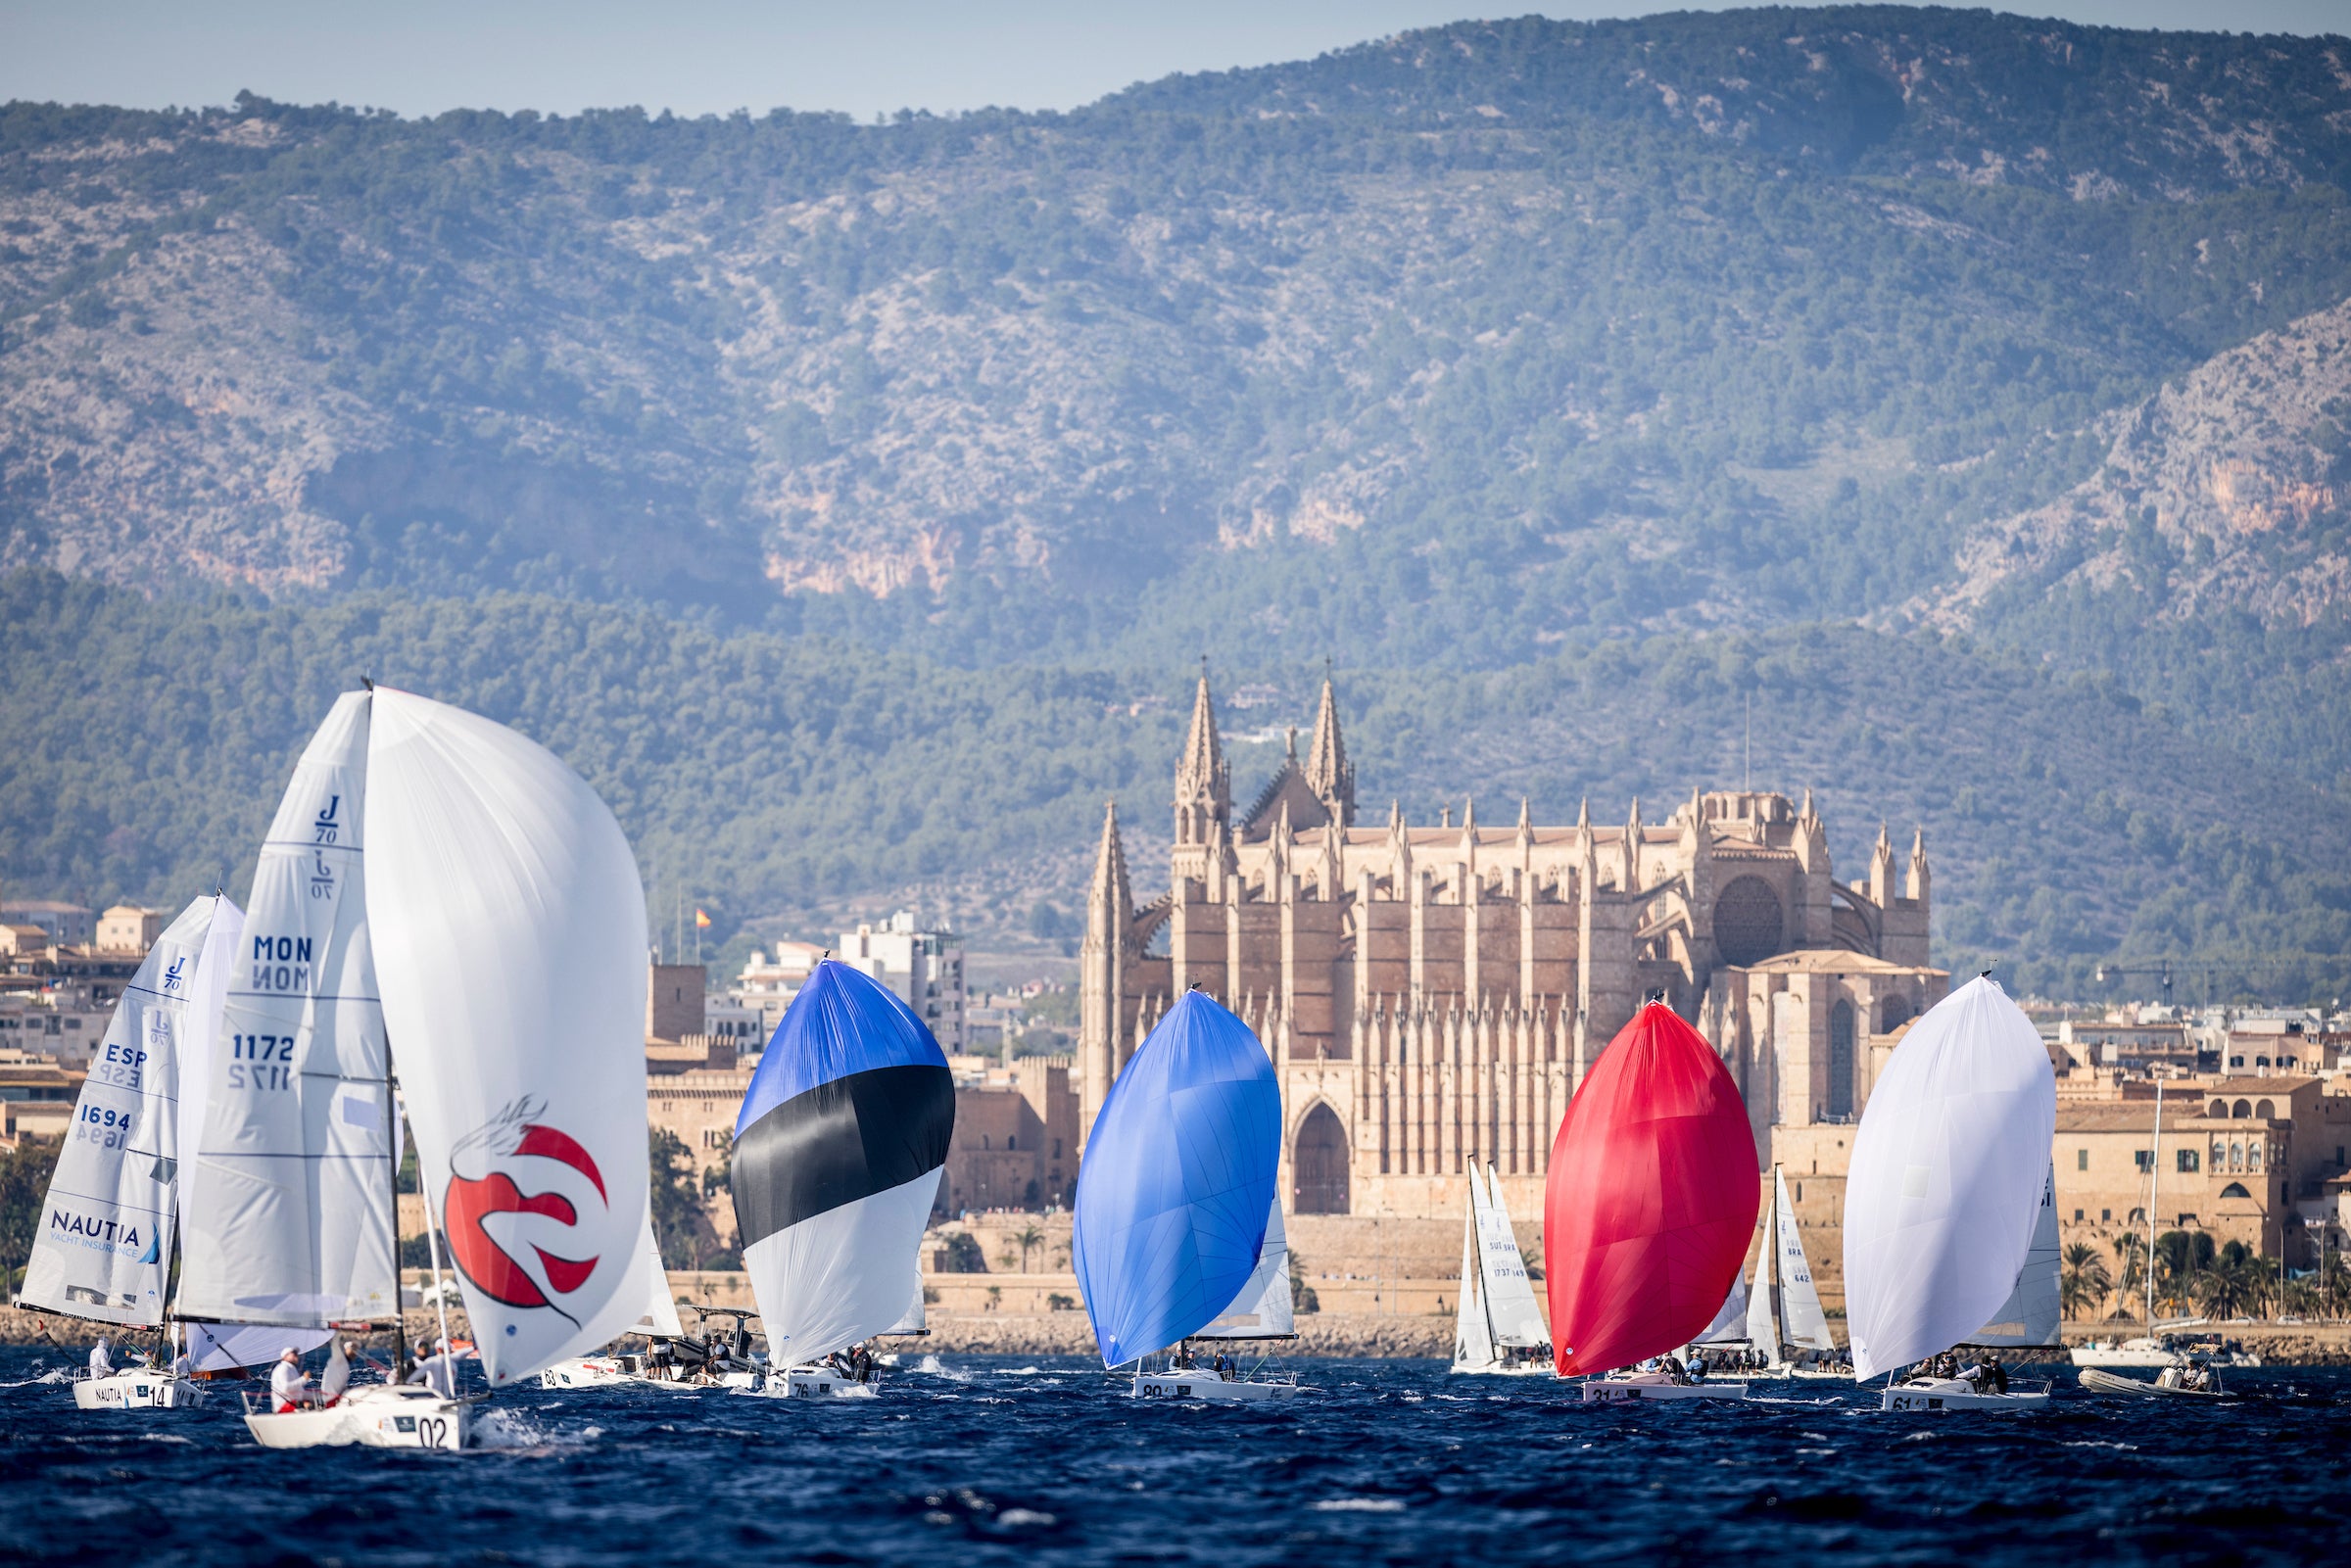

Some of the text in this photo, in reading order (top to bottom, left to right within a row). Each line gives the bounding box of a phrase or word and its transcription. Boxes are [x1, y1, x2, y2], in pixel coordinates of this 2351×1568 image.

[319, 795, 340, 821] J
[315, 828, 337, 843] 70
[254, 935, 312, 962] MON
[168, 957, 186, 974] J
[164, 978, 180, 990] 70
[106, 1044, 148, 1068] ESP
[233, 1034, 295, 1061] 1172
[81, 1104, 130, 1131] 1694
[51, 1209, 139, 1247] NAUTIA
[50, 1231, 138, 1258] YACHT INSURANCE
[1788, 1247, 1801, 1256] BRA
[1795, 1274, 1809, 1283] 642
[545, 1368, 556, 1387] 63
[95, 1388, 122, 1402] NAUTIA
[150, 1386, 165, 1407] 14
[794, 1383, 809, 1399] 76
[1593, 1389, 1610, 1402] 31
[1893, 1397, 1911, 1410] 61
[419, 1417, 447, 1449] 02
